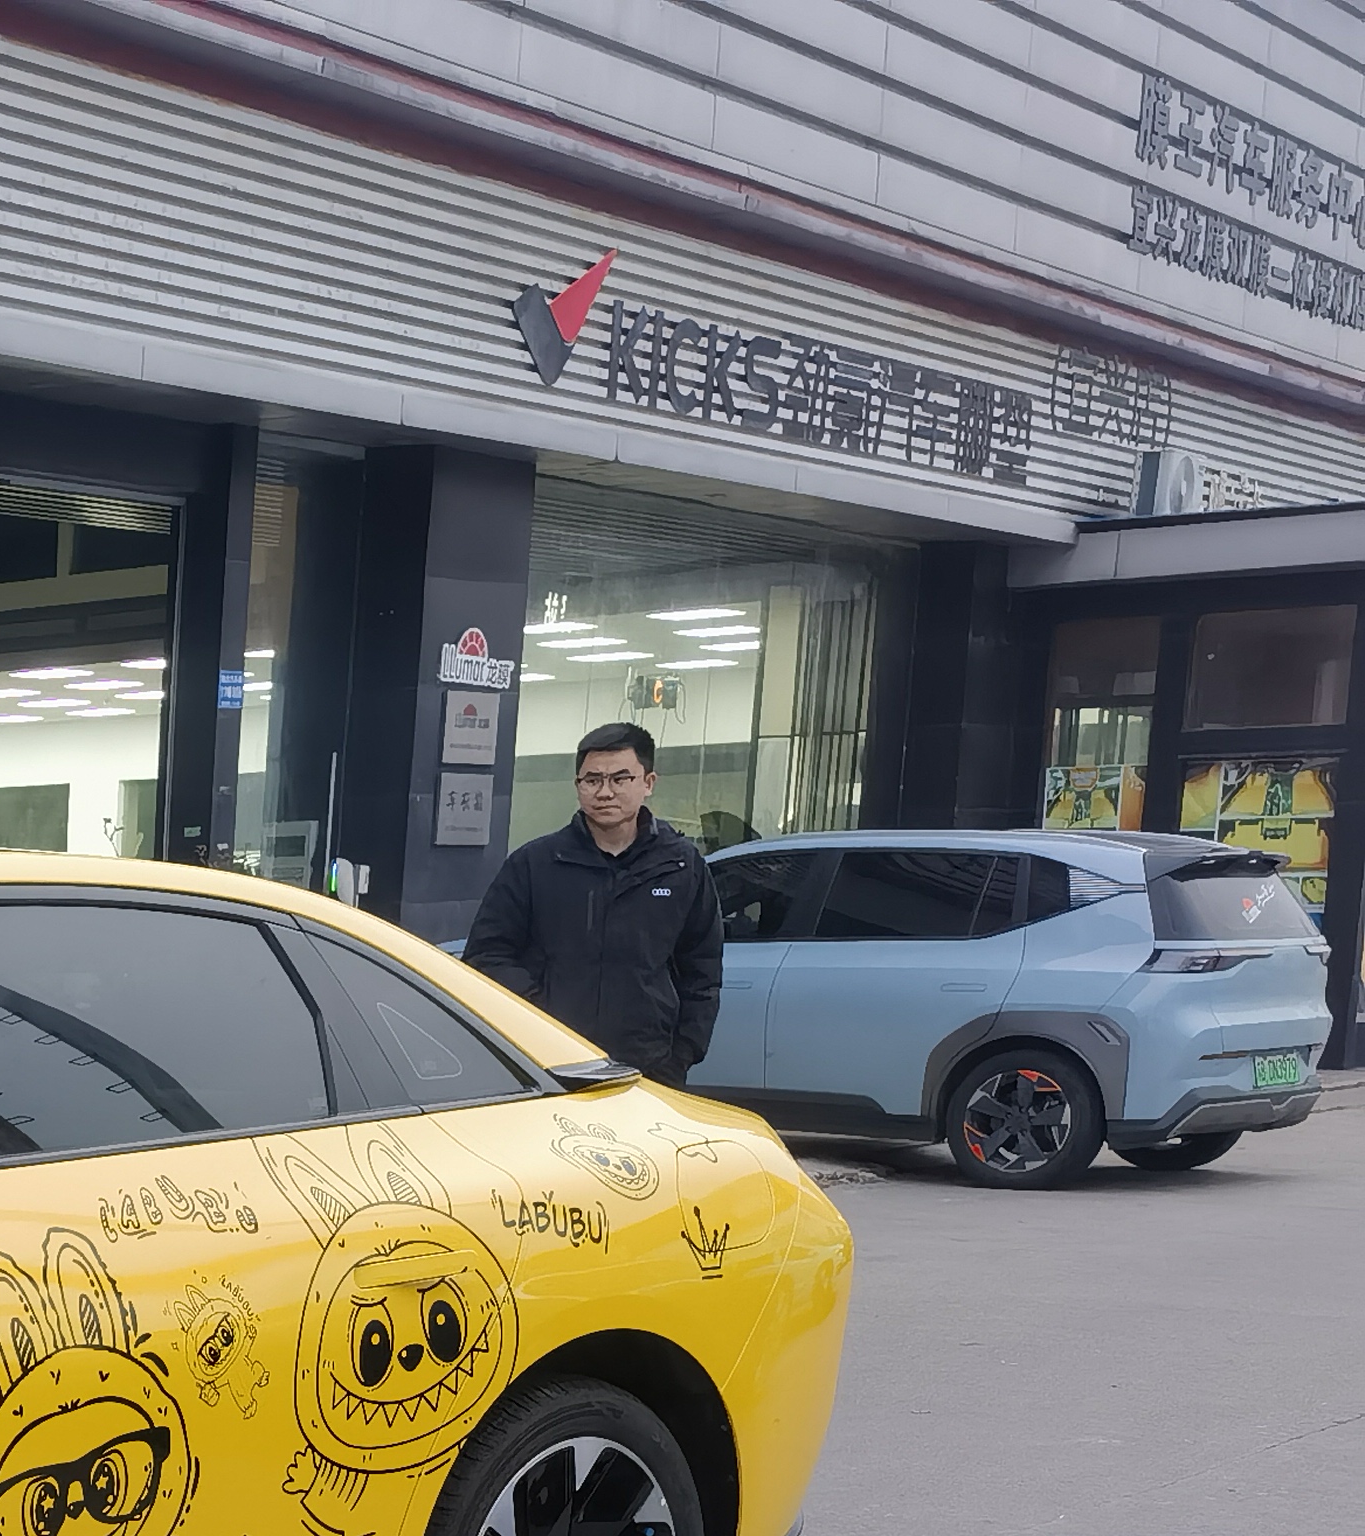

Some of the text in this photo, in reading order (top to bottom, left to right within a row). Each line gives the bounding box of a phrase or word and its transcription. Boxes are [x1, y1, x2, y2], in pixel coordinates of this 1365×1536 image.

[607, 300, 781, 430] KICKS
[100, 1174, 259, 1243] LABUBU
[498, 1195, 602, 1245] LABUBU
